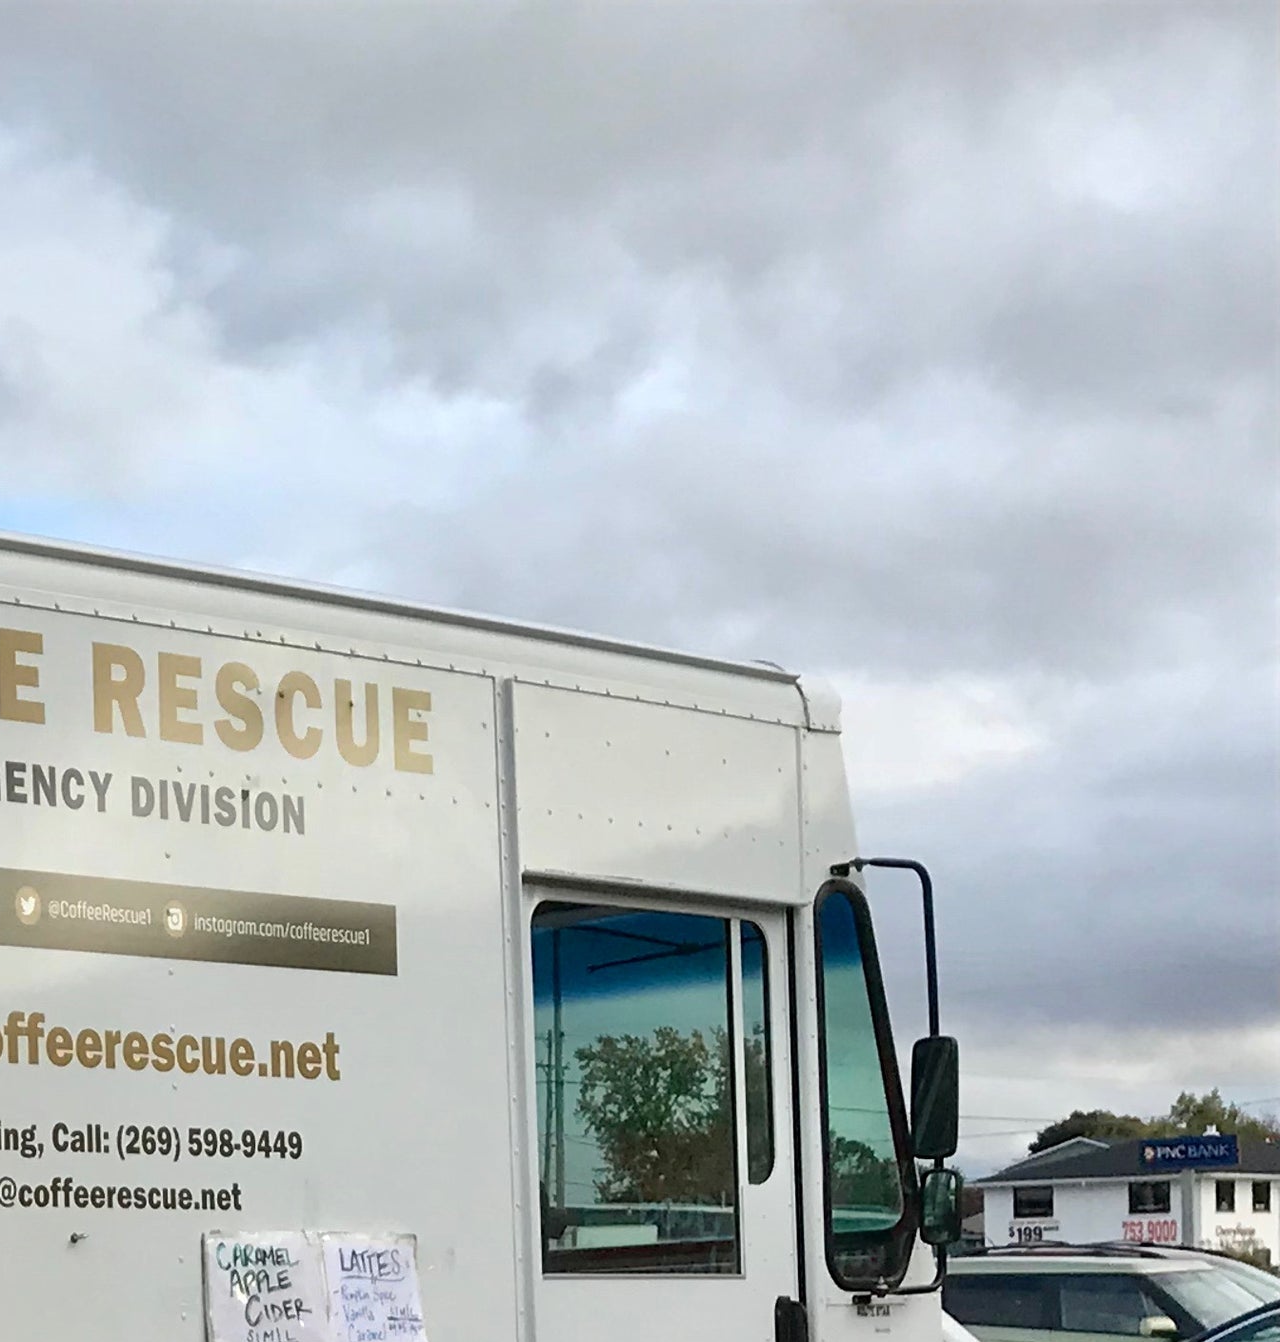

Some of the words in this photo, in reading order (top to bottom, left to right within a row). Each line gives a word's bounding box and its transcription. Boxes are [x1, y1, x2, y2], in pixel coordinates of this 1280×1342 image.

[91, 641, 436, 776] RESCUE
[130, 775, 307, 836] DIVISION
[48, 899, 151, 926] @CoffeeRescue1
[194, 912, 371, 946] instagram.com/coffeerescue1
[52, 1123, 111, 1155] Call:
[117, 1125, 182, 1162] (269)
[188, 1127, 303, 1160] 598-9449
[1156, 1144, 1186, 1159] PNC
[1187, 1143, 1230, 1158] BANK
[216, 1242, 300, 1271] CARAMEL
[338, 1247, 402, 1278] LATTES
[229, 1269, 292, 1297] APPLE
[245, 1295, 313, 1327] CIDER
